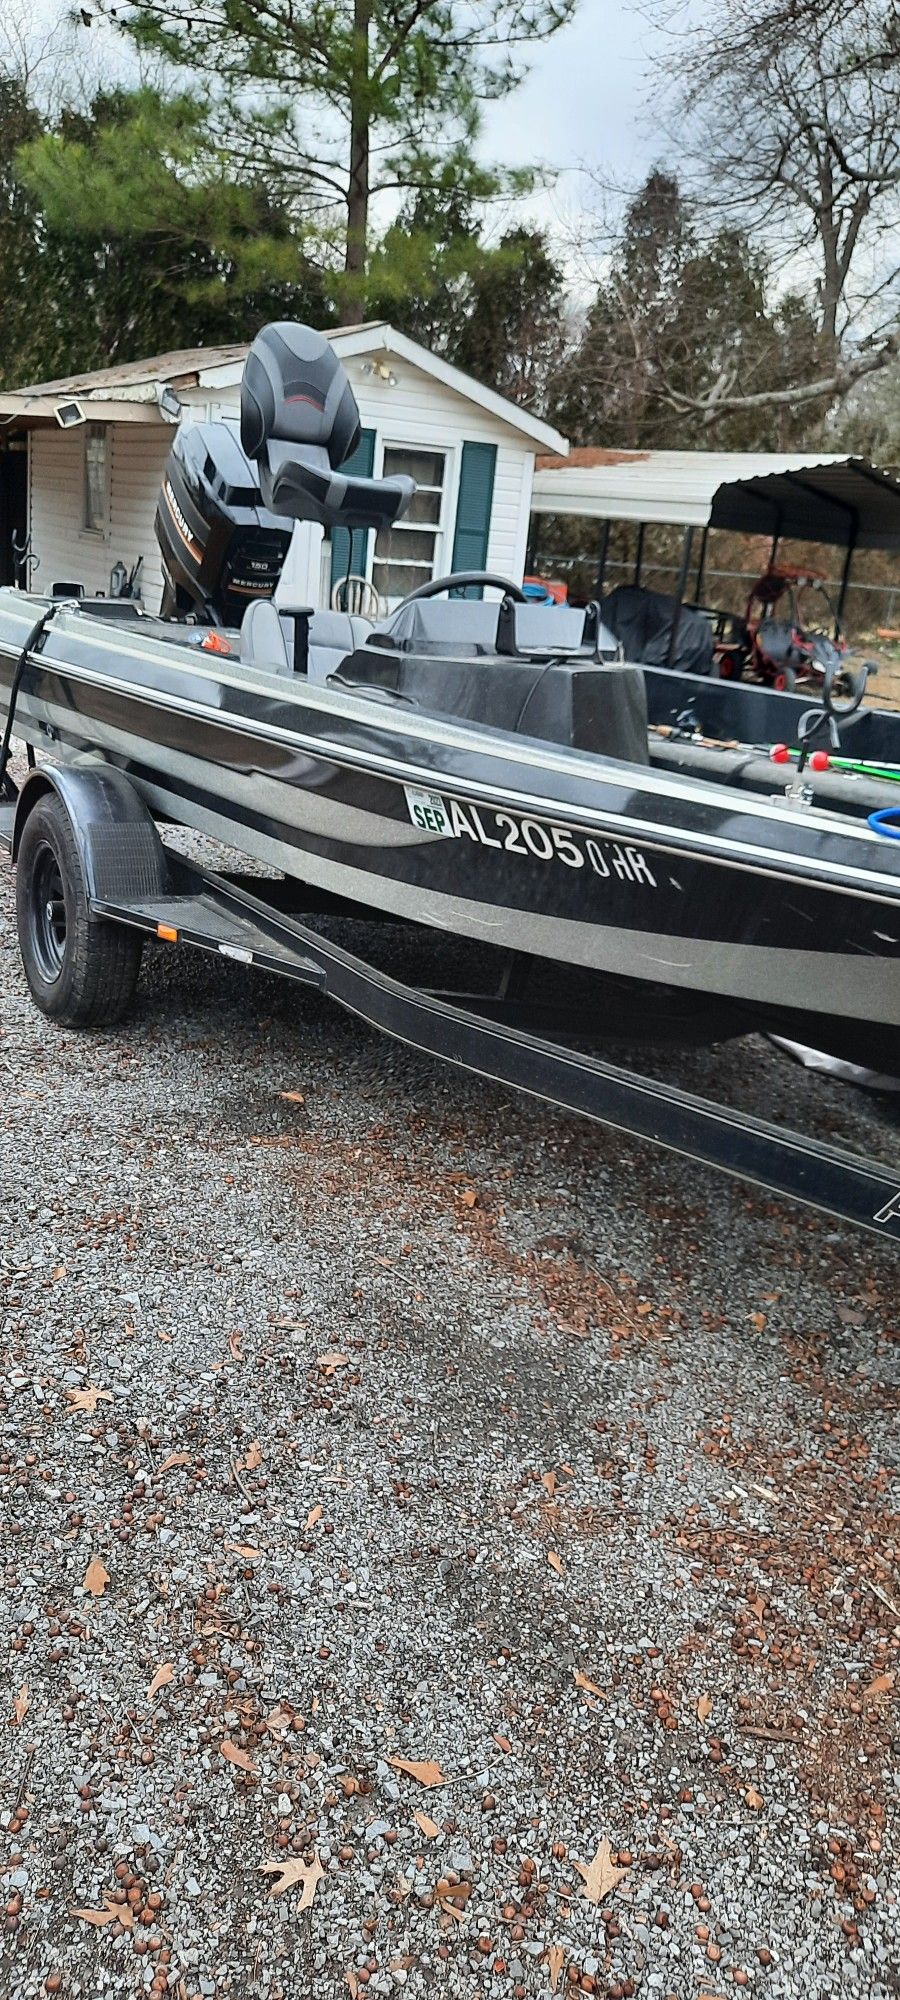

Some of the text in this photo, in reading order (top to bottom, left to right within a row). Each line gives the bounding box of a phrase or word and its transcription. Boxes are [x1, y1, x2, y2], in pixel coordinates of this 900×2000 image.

[251, 562, 268, 570] 150
[232, 578, 274, 588] MERCURY
[413, 804, 445, 832] SEP
